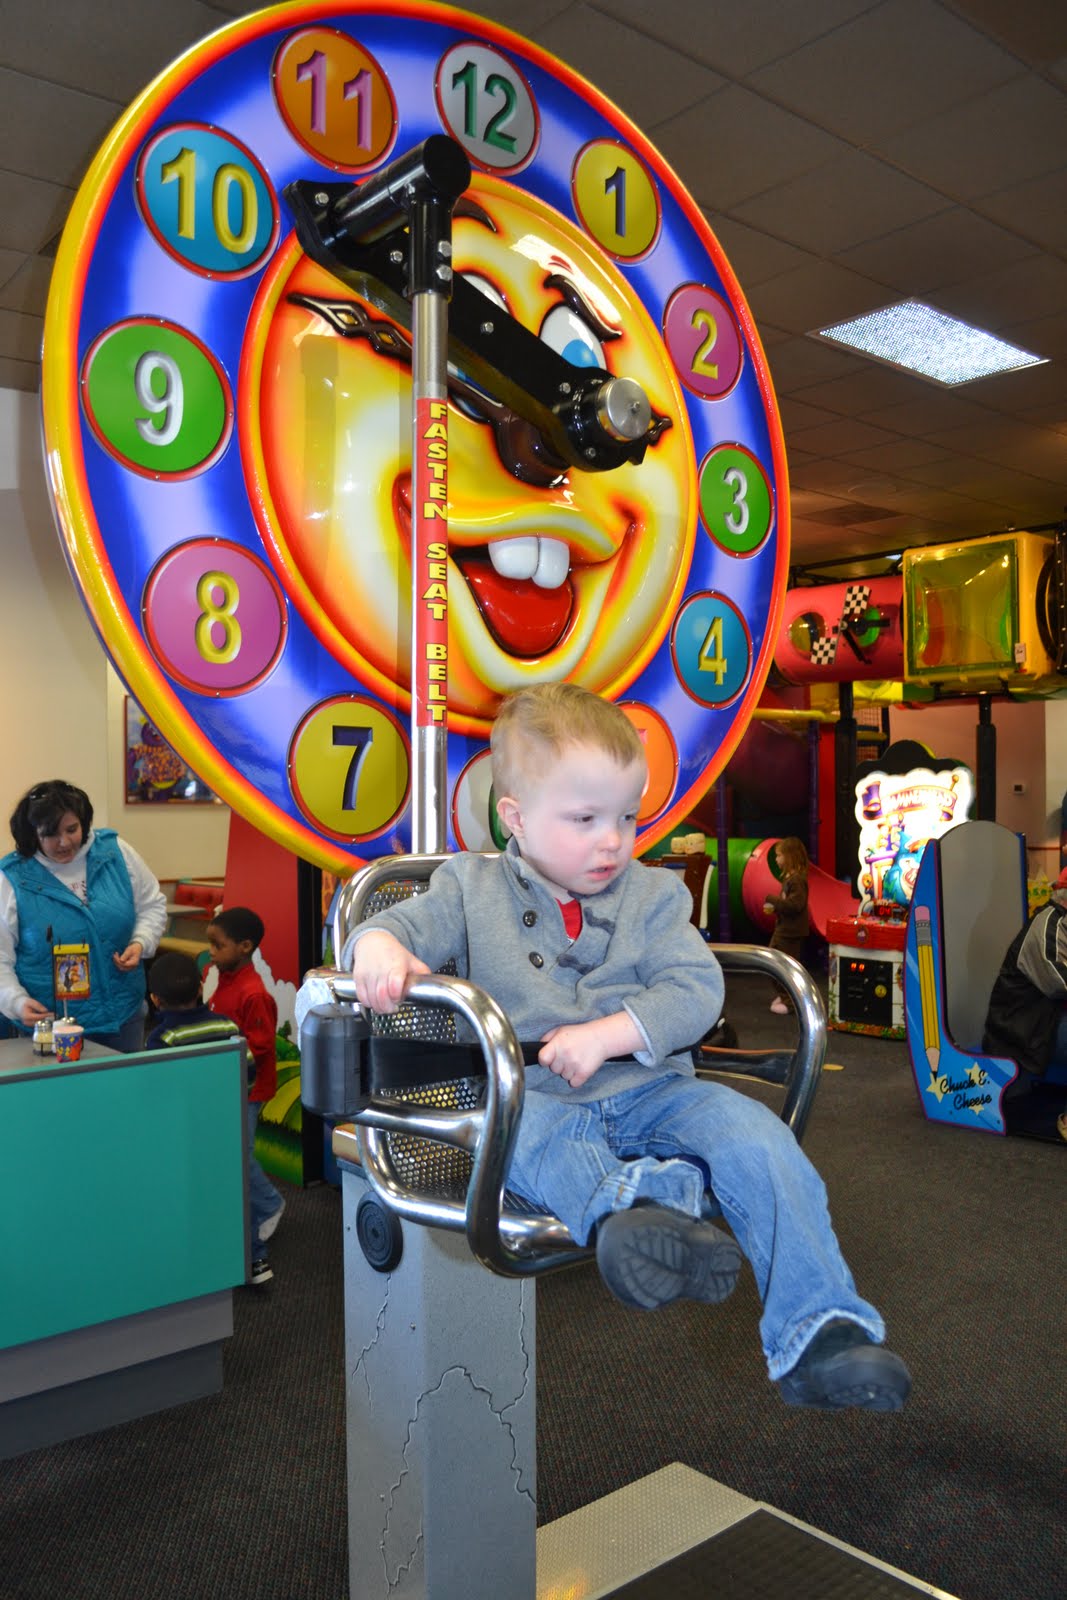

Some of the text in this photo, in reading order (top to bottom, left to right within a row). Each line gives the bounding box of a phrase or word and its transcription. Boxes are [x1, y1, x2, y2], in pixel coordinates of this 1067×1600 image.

[296, 49, 373, 152] 11
[452, 61, 518, 155] 12
[161, 147, 258, 254] 10
[605, 166, 627, 238] 1
[691, 308, 718, 380] 2
[134, 350, 184, 446] 9
[722, 466, 750, 535] 3
[422, 402, 448, 721] FASTEN SEAT BELT
[194, 570, 242, 665] 8
[697, 616, 727, 686] 4
[332, 725, 373, 811] 7
[940, 1071, 976, 1094] Chuck
[953, 1092, 993, 1110] Cheese
